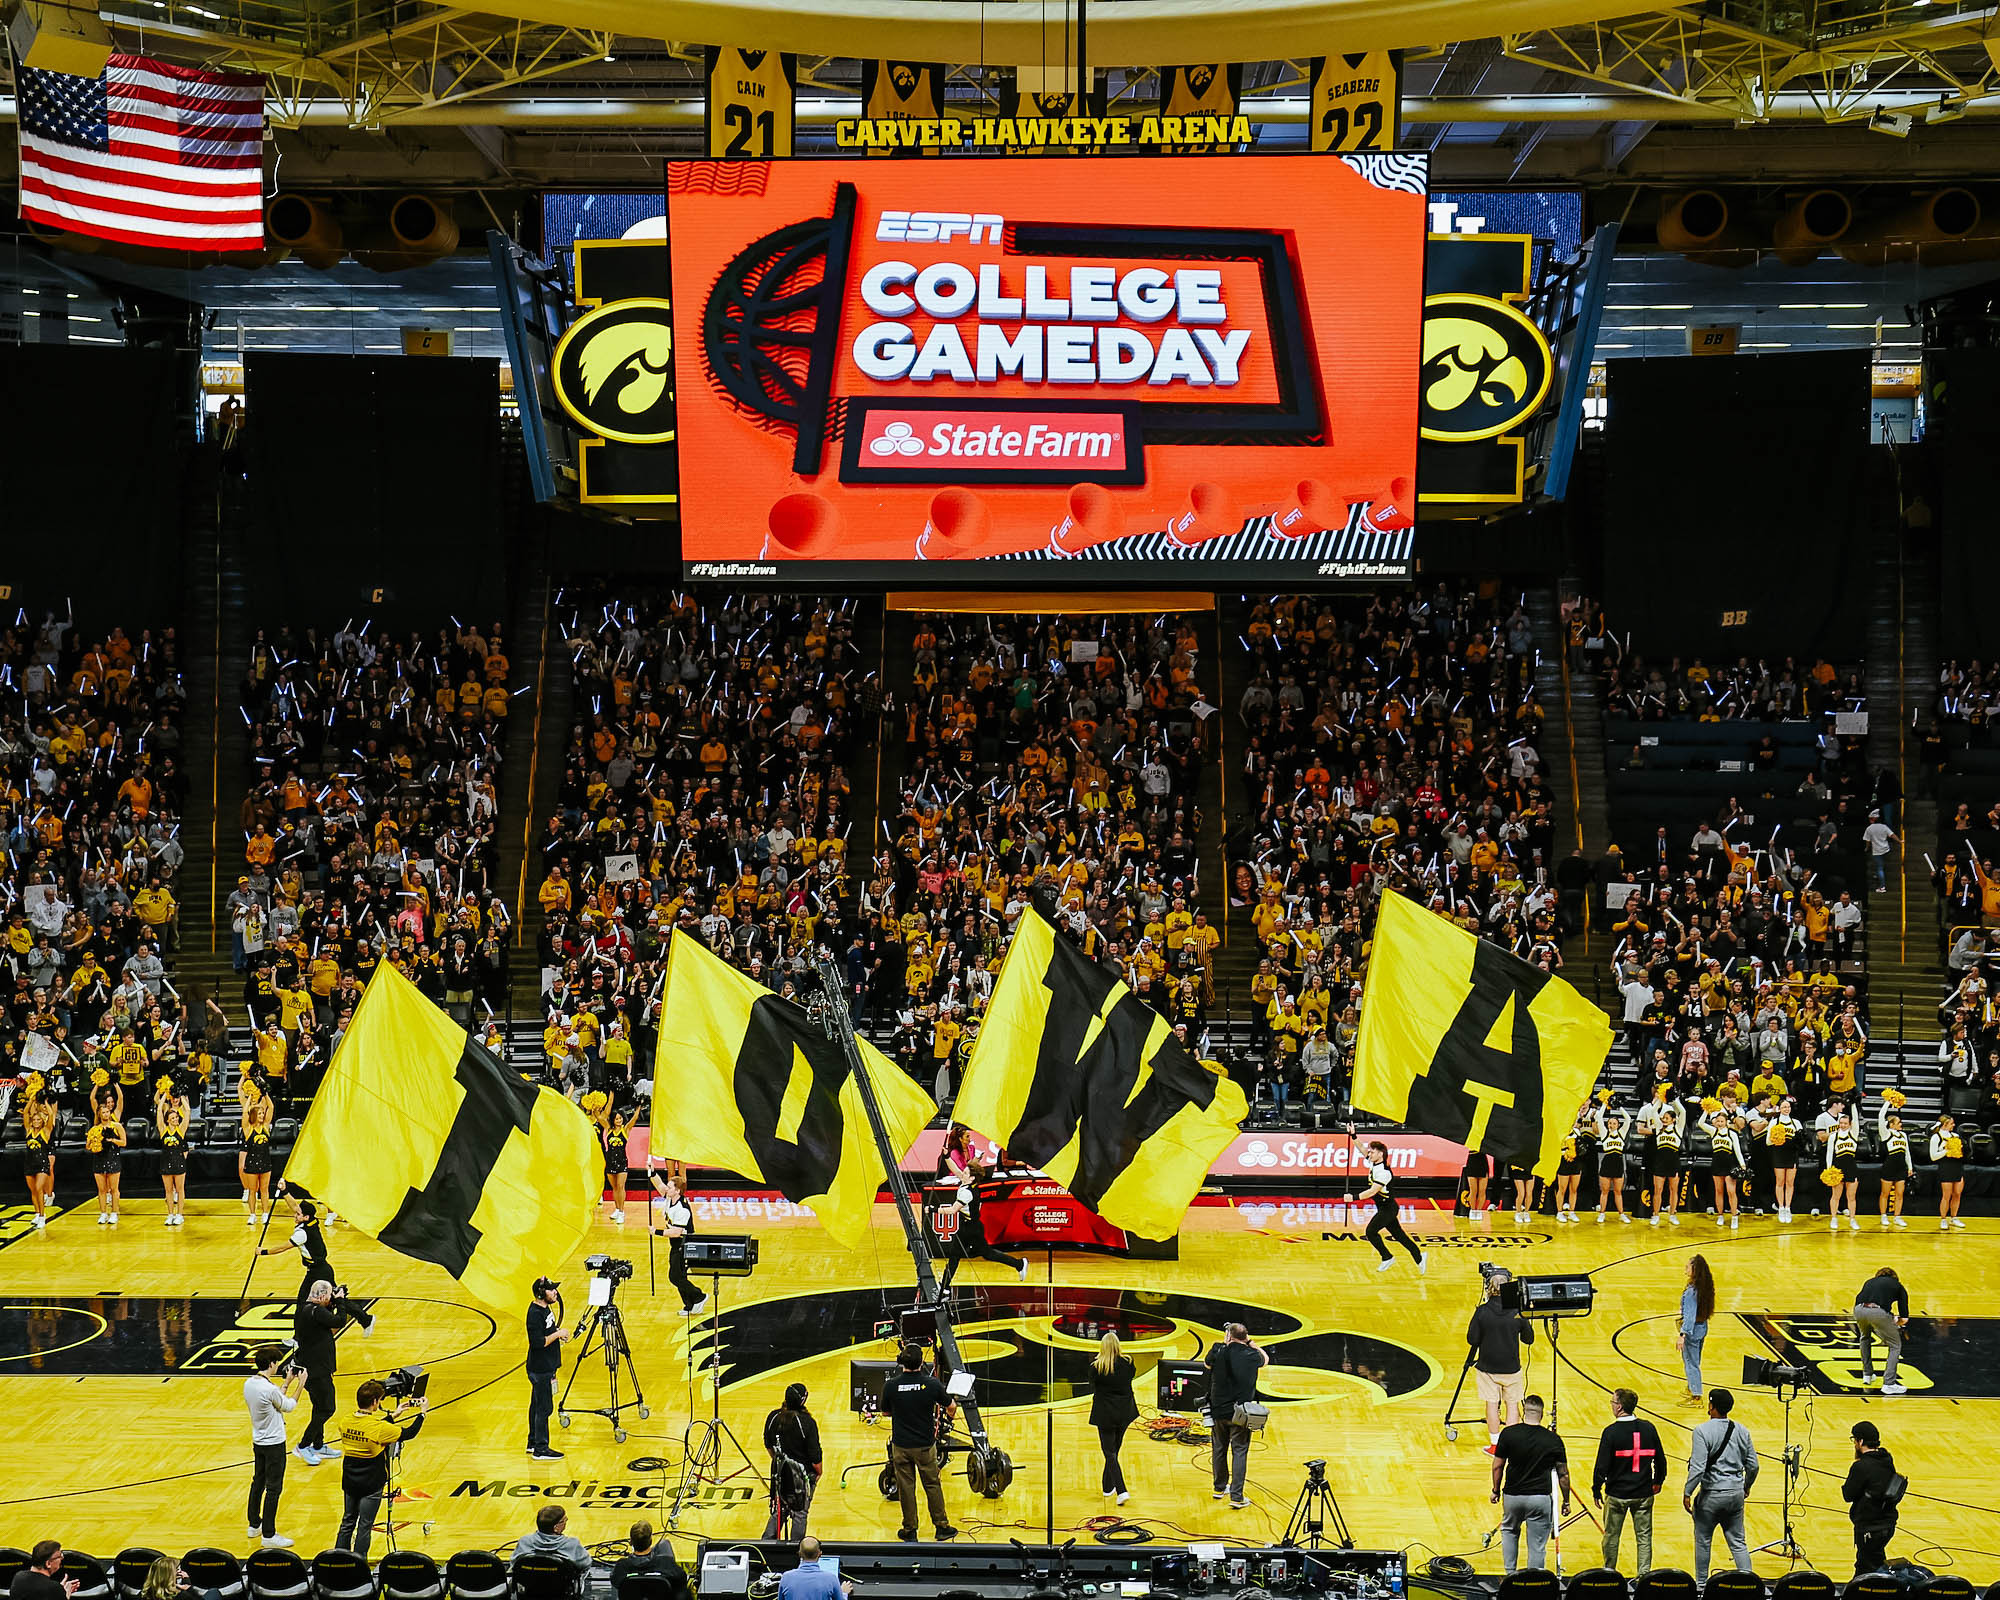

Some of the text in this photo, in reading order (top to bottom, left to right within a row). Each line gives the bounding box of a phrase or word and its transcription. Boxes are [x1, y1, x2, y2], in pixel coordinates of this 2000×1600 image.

[736, 80, 766, 98] CAIN
[1327, 78, 1381, 101] SEABERG
[724, 103, 775, 157] 21
[836, 115, 1253, 147] CARVER-HAWKEYE ARENA
[1321, 101, 1384, 151] 22
[875, 211, 1004, 245] ESPN
[860, 260, 1227, 324] COLLEGE
[422, 337, 432, 348] C
[1703, 333, 1723, 345] BB
[852, 322, 1252, 386] GAMEDAY
[690, 563, 777, 577] #FightForIowa
[1317, 562, 1406, 577] #FightForIowa
[371, 588, 384, 603] C
[1721, 610, 1748, 626] BB
[1150, 768, 1164, 777] IOWA
[1184, 1009, 1196, 1017] 25
[1687, 1003, 1702, 1018] 14
[124, 1052, 138, 1060] GO
[734, 992, 855, 1202] O
[1009, 924, 1218, 1213] W
[1404, 938, 1545, 1170] A
[1659, 1135, 1676, 1143] IOWA
[1837, 1142, 1854, 1150] IOWA
[897, 1383, 928, 1393] ESPN+
[342, 1432, 369, 1443] SECURITY
[449, 1479, 755, 1501] Mediacom
[579, 1500, 749, 1511] COURT
